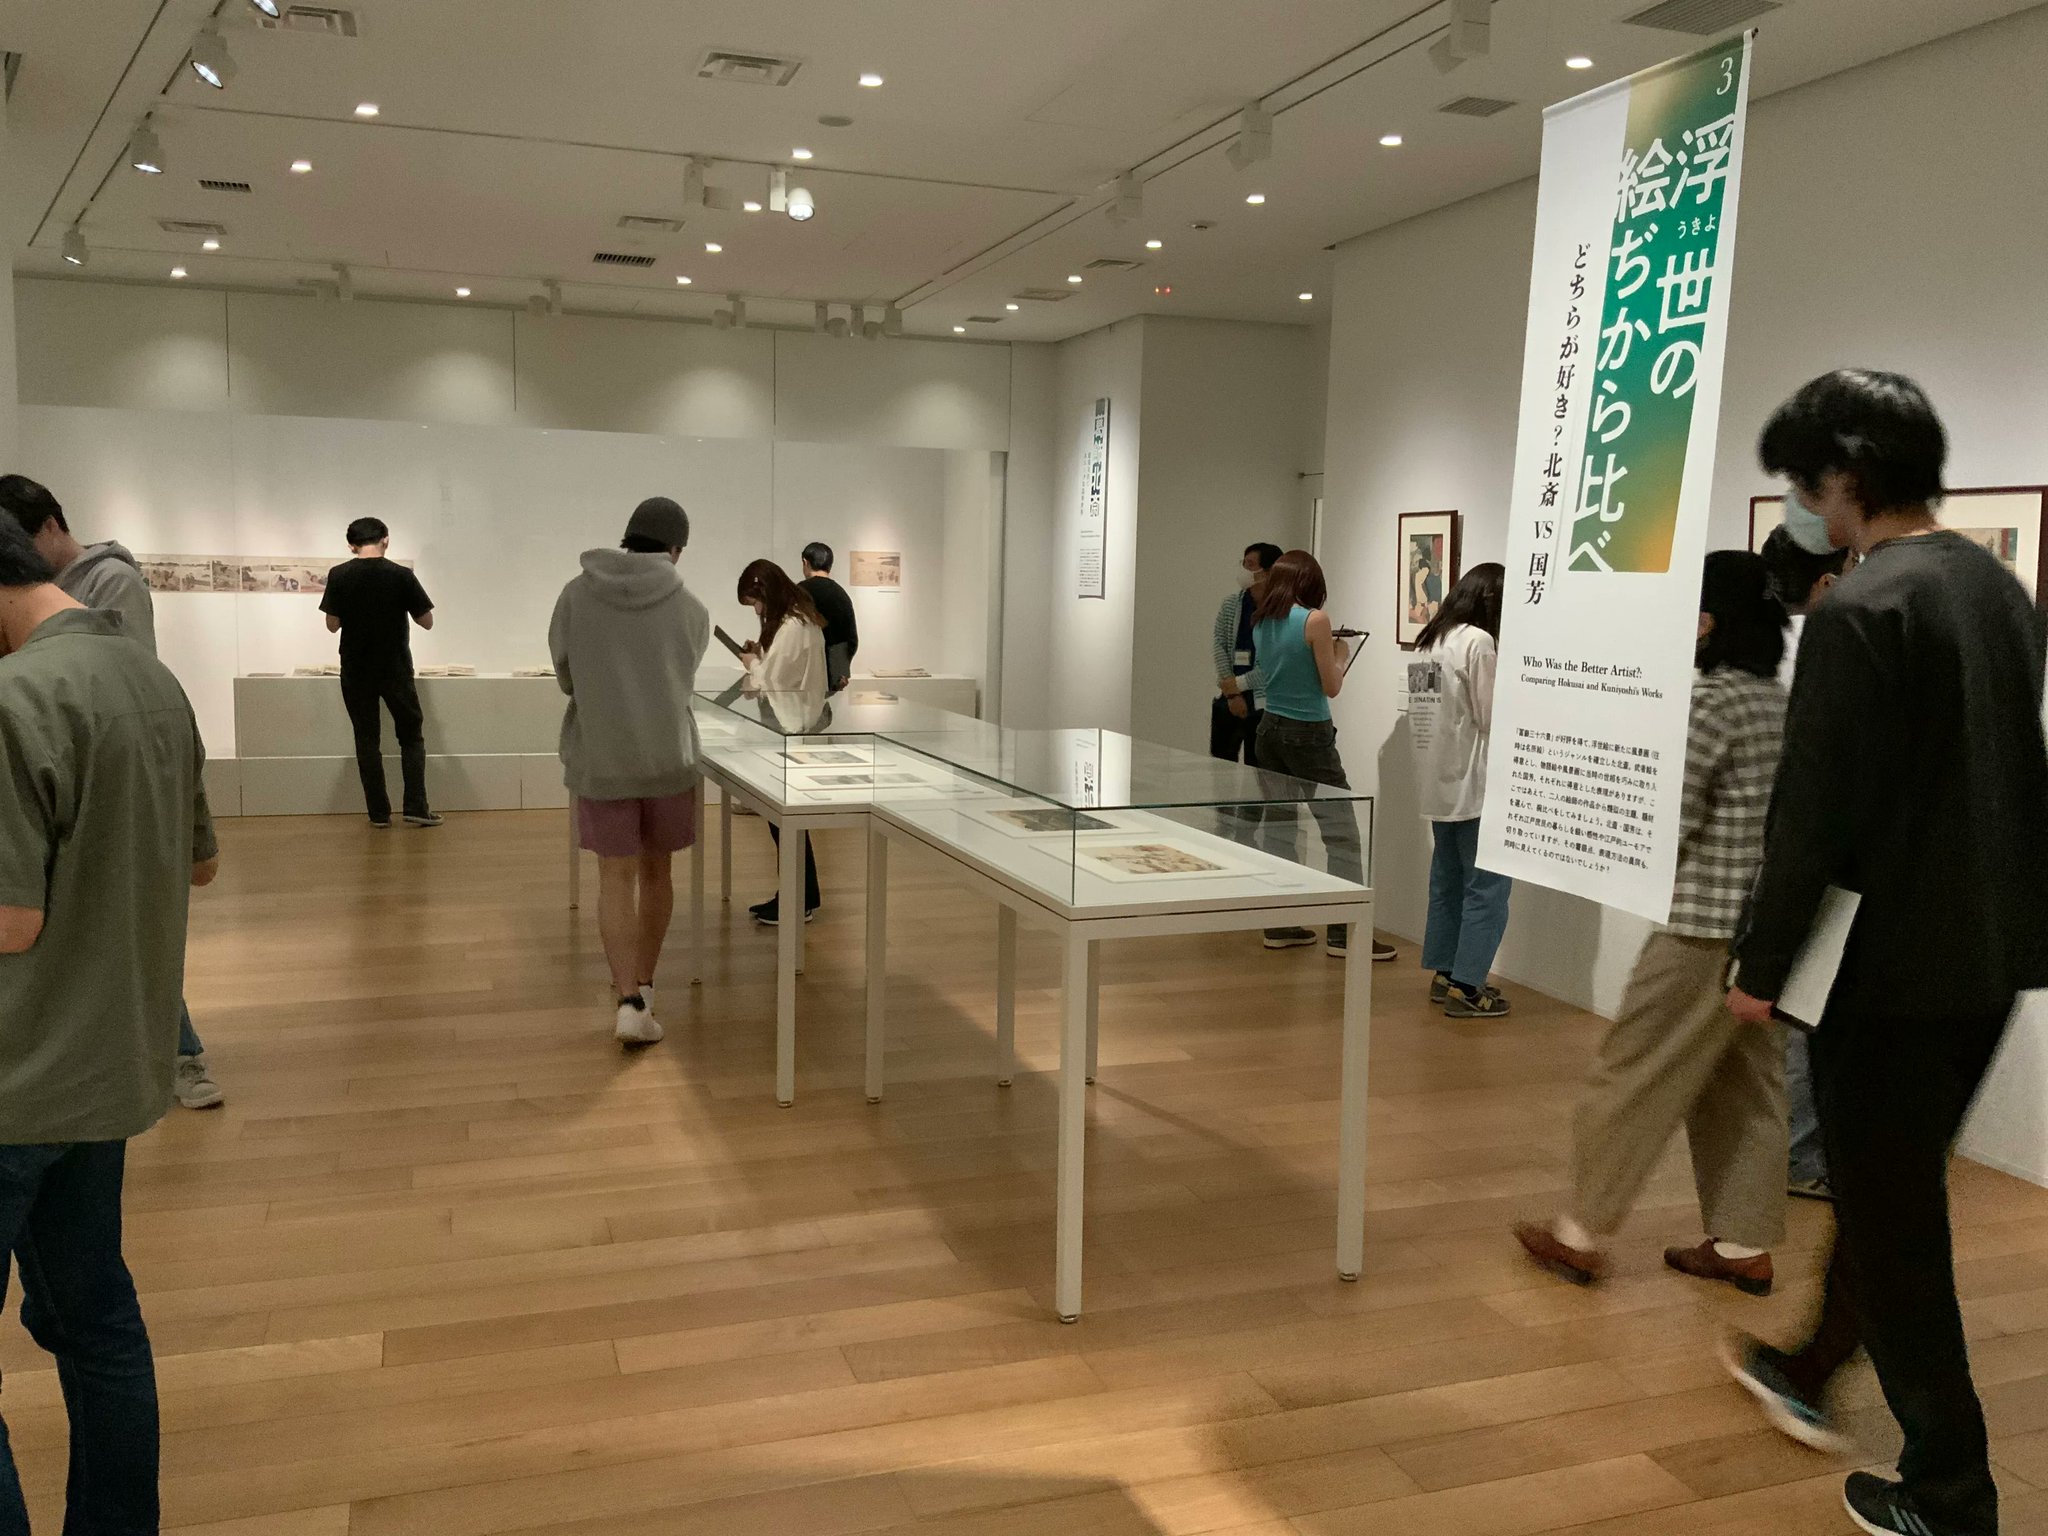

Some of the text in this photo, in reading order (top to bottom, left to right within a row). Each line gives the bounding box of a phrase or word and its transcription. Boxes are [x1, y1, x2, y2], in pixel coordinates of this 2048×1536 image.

[1716, 57, 1732, 96] 3
[1678, 214, 1717, 239] うきよ
[1650, 112, 1736, 400] 浮世の
[1568, 137, 1673, 573] 絵ぢから比べ
[1534, 520, 1554, 539] VS
[1523, 552, 1549, 606] 国芳
[1523, 655, 1642, 679] Who Was the Better Artist?:
[1521, 674, 1663, 699] Comparing Hokusai and Kuniyoshi's Works
